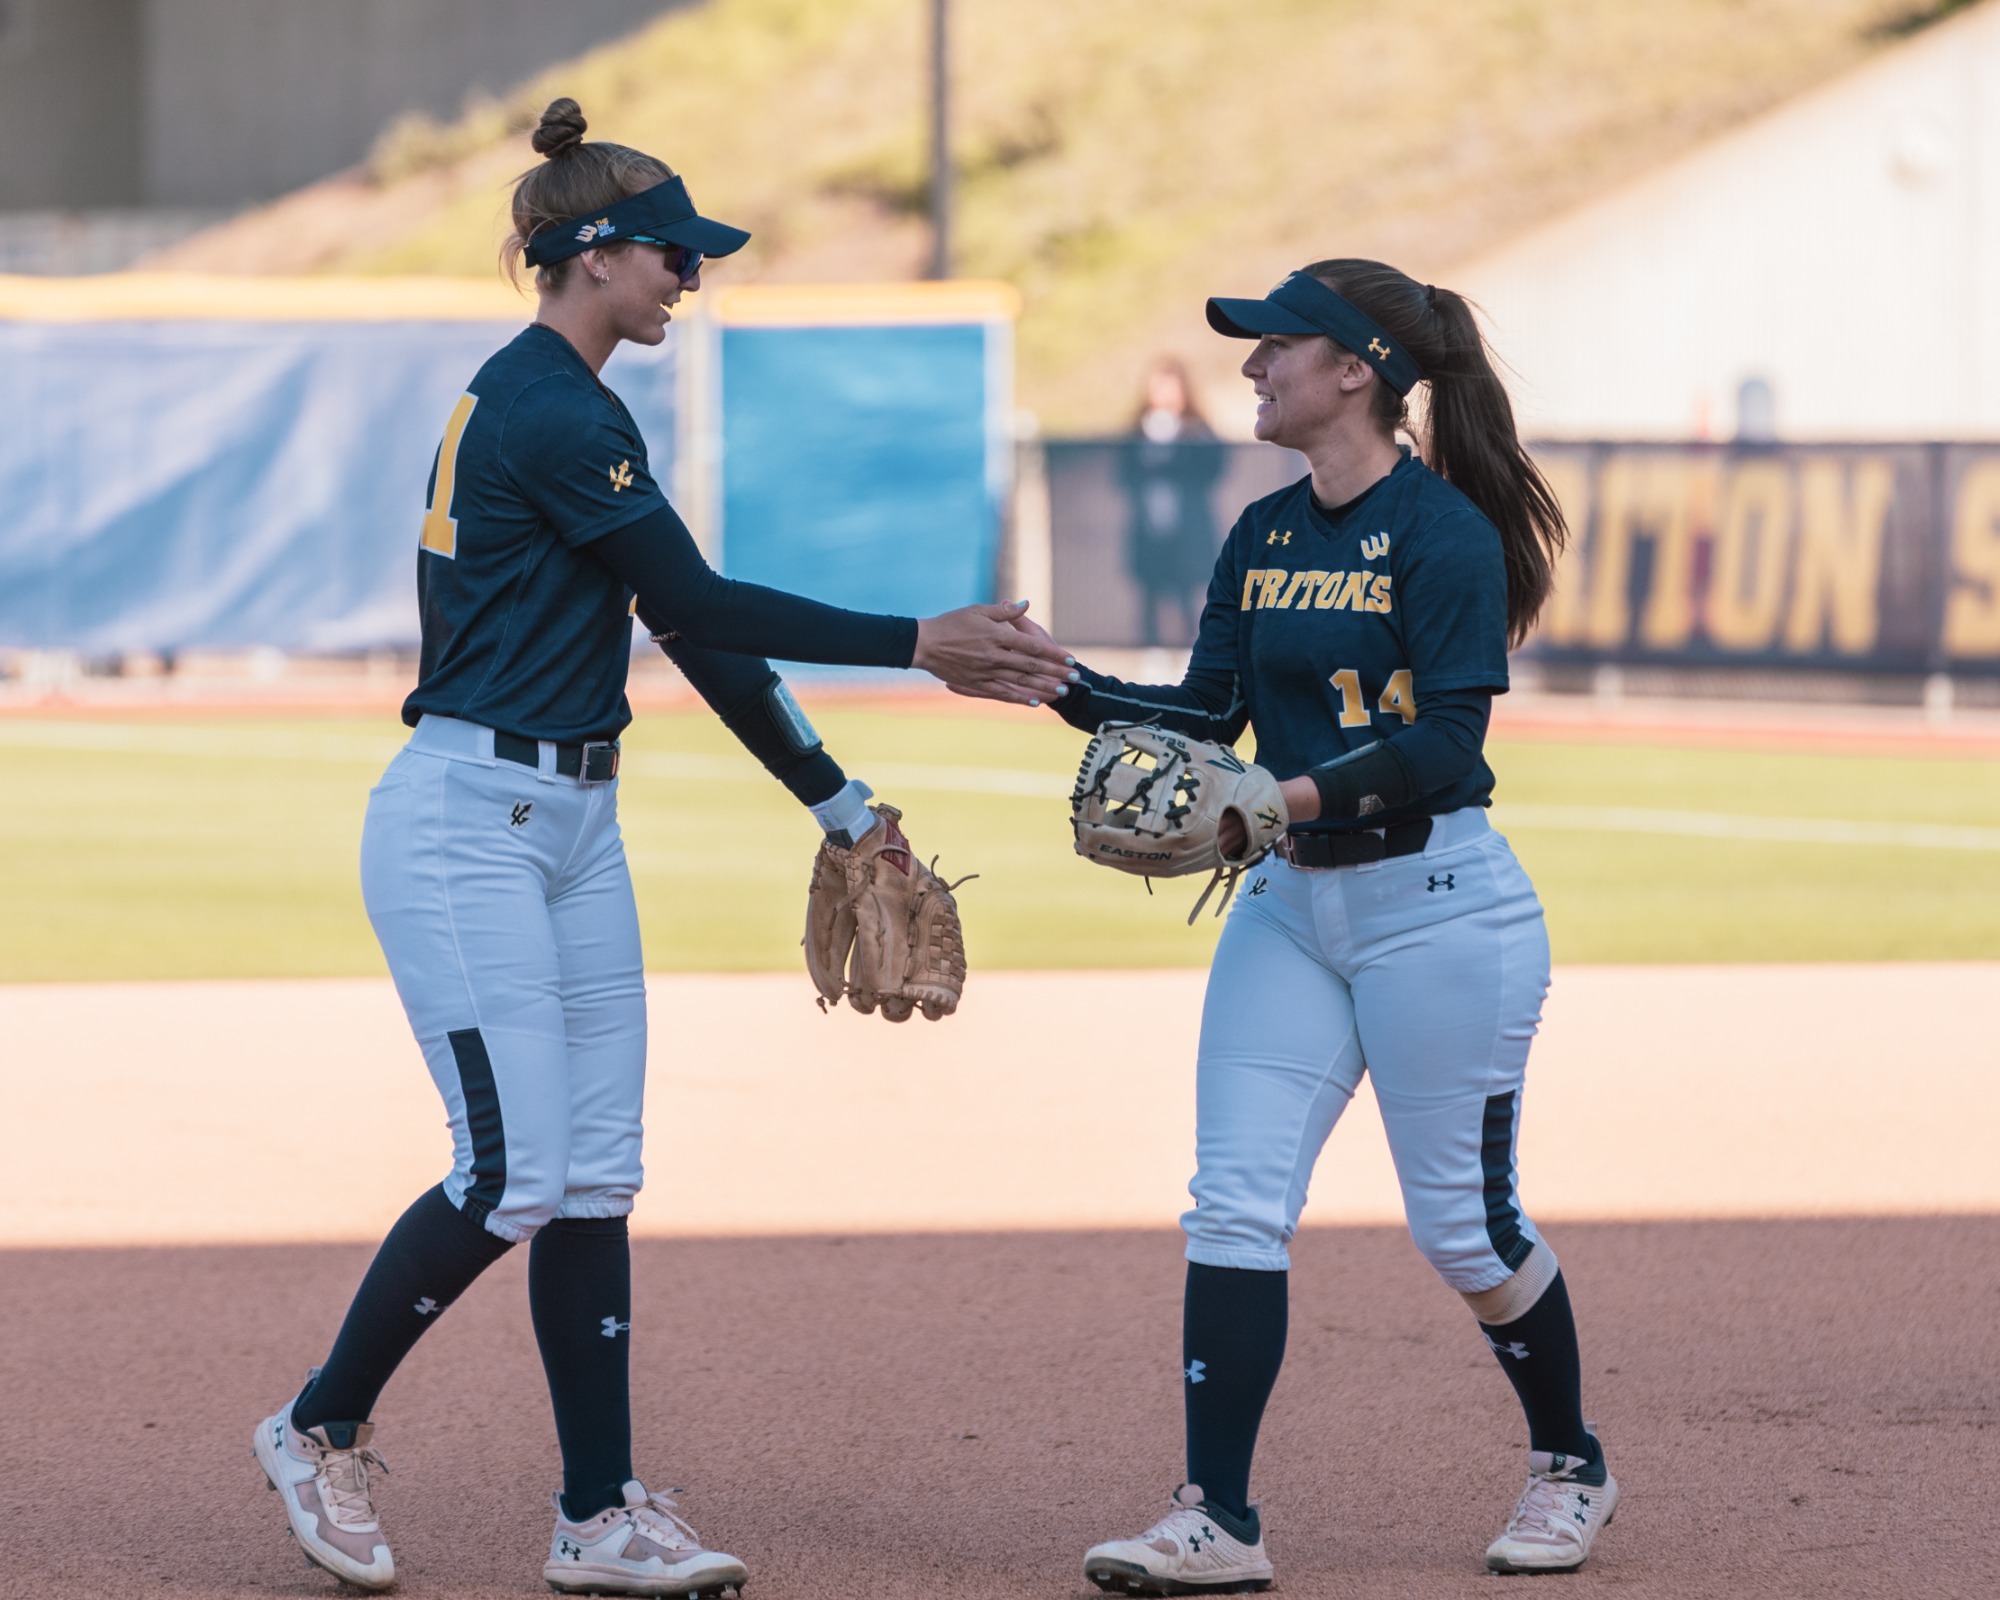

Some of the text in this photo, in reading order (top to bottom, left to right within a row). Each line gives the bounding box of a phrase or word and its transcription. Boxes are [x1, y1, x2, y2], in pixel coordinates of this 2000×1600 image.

[420, 391, 479, 560] 1
[1241, 569, 1392, 614] TRITONS
[1329, 669, 1417, 728] 14
[1099, 843, 1173, 861] EASTON
